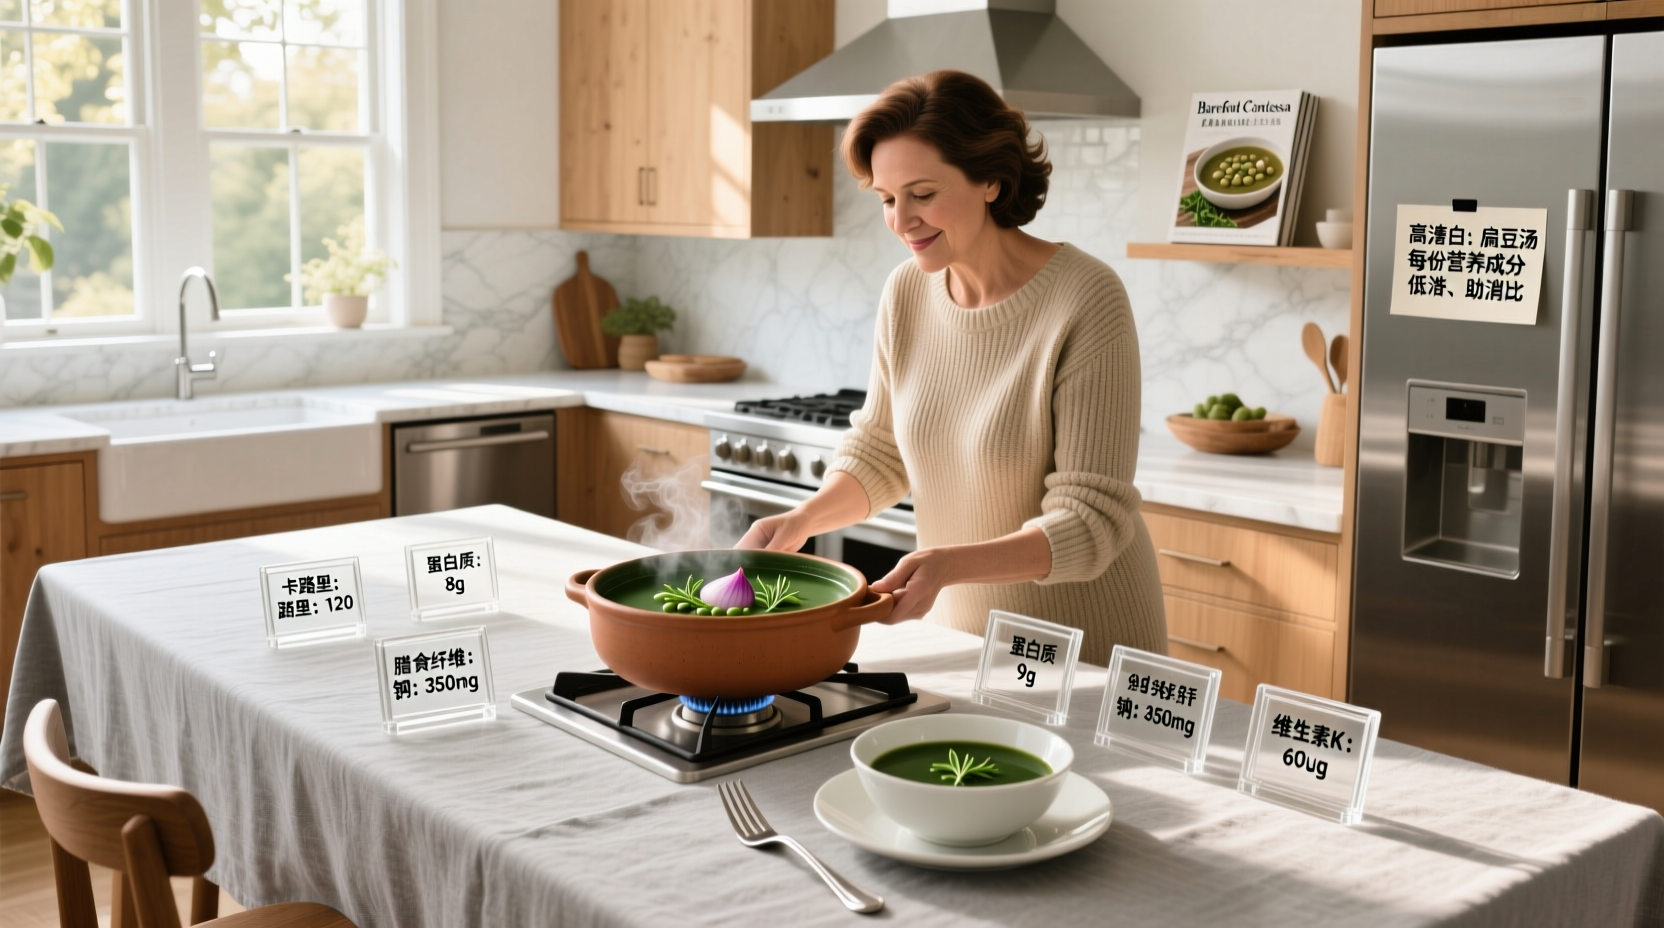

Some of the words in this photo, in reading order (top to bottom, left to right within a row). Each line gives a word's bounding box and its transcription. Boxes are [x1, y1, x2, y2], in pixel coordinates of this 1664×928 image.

[1407, 248, 1526, 276] 每份营养成分
[445, 576, 465, 595] 8g
[1017, 662, 1037, 688] 9g
